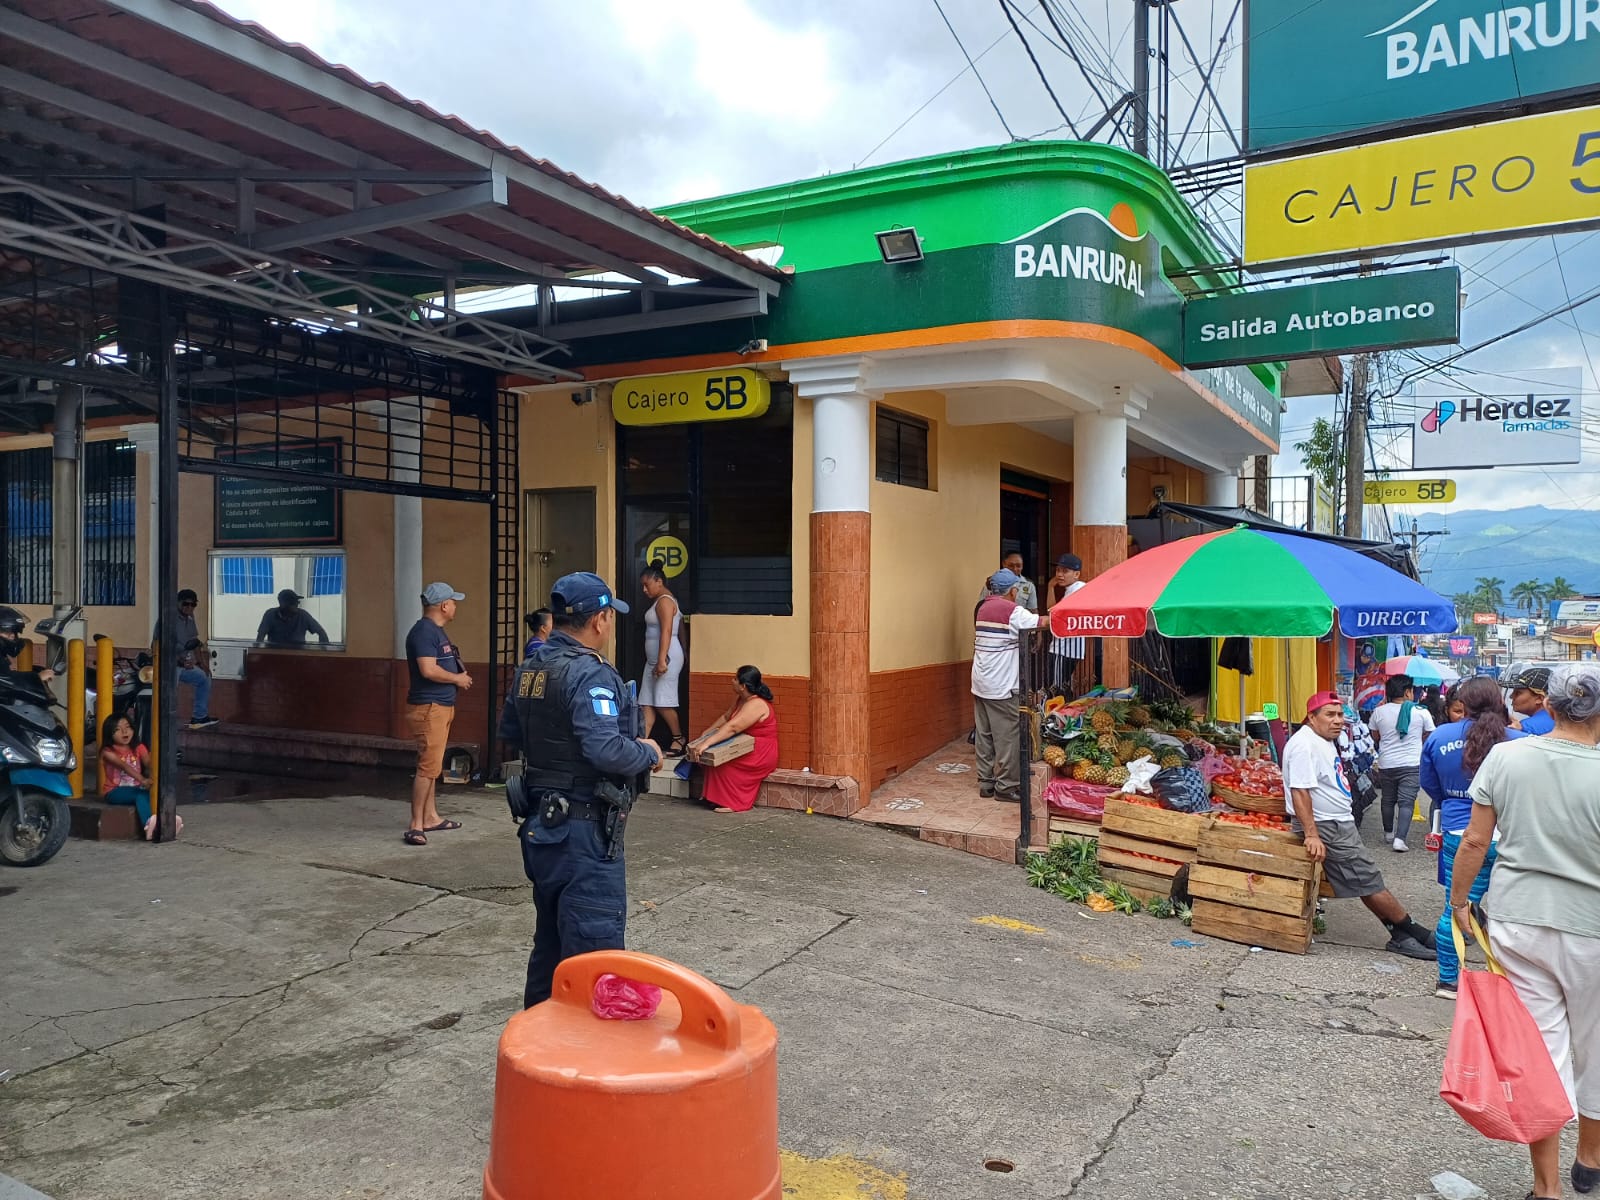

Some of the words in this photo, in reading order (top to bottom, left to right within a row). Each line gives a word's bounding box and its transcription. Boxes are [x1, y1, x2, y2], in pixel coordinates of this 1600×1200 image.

[1283, 155, 1536, 224] CAJERO
[1014, 244, 1145, 297] BANRURAL
[1200, 317, 1277, 342] Salida
[1286, 301, 1435, 332] Autobanco
[627, 389, 689, 411] Cajero
[705, 375, 748, 411] 5B
[1460, 394, 1571, 422] Herdez
[1502, 418, 1571, 433] farmacias
[1364, 487, 1408, 499] Cajero
[1417, 482, 1446, 500] 5B
[652, 547, 683, 568] 5B
[1066, 614, 1126, 631] DIRECT
[1357, 609, 1430, 629] DIRECT
